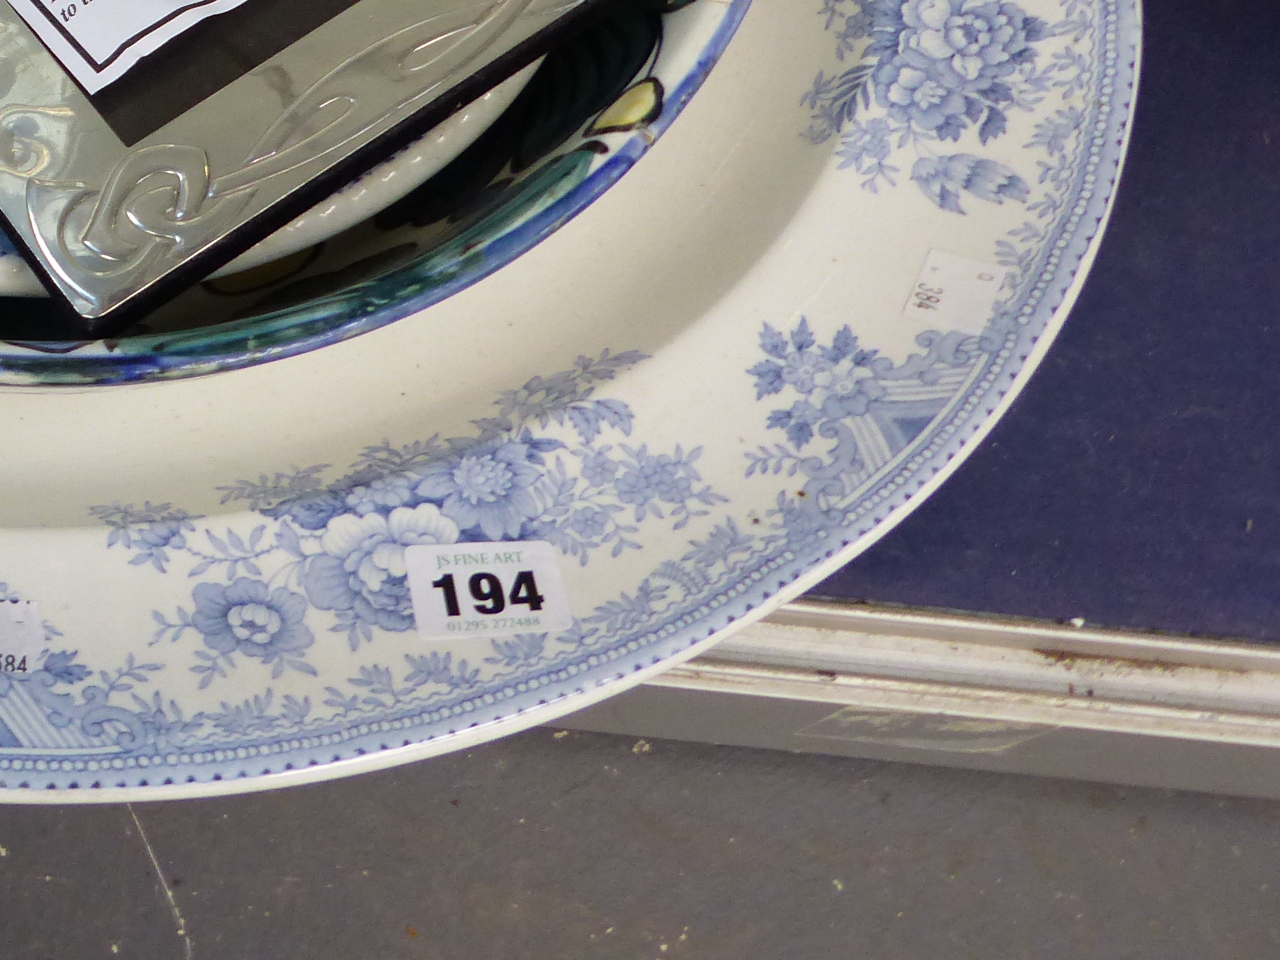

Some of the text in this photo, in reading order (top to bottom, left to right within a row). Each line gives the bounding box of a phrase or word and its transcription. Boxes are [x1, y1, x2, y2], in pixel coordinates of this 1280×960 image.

[60, 3, 77, 22] to
[913, 282, 944, 311] 384
[436, 550, 524, 569] JS FINE ART
[432, 570, 545, 617] 194
[446, 616, 541, 633] 01295 272488
